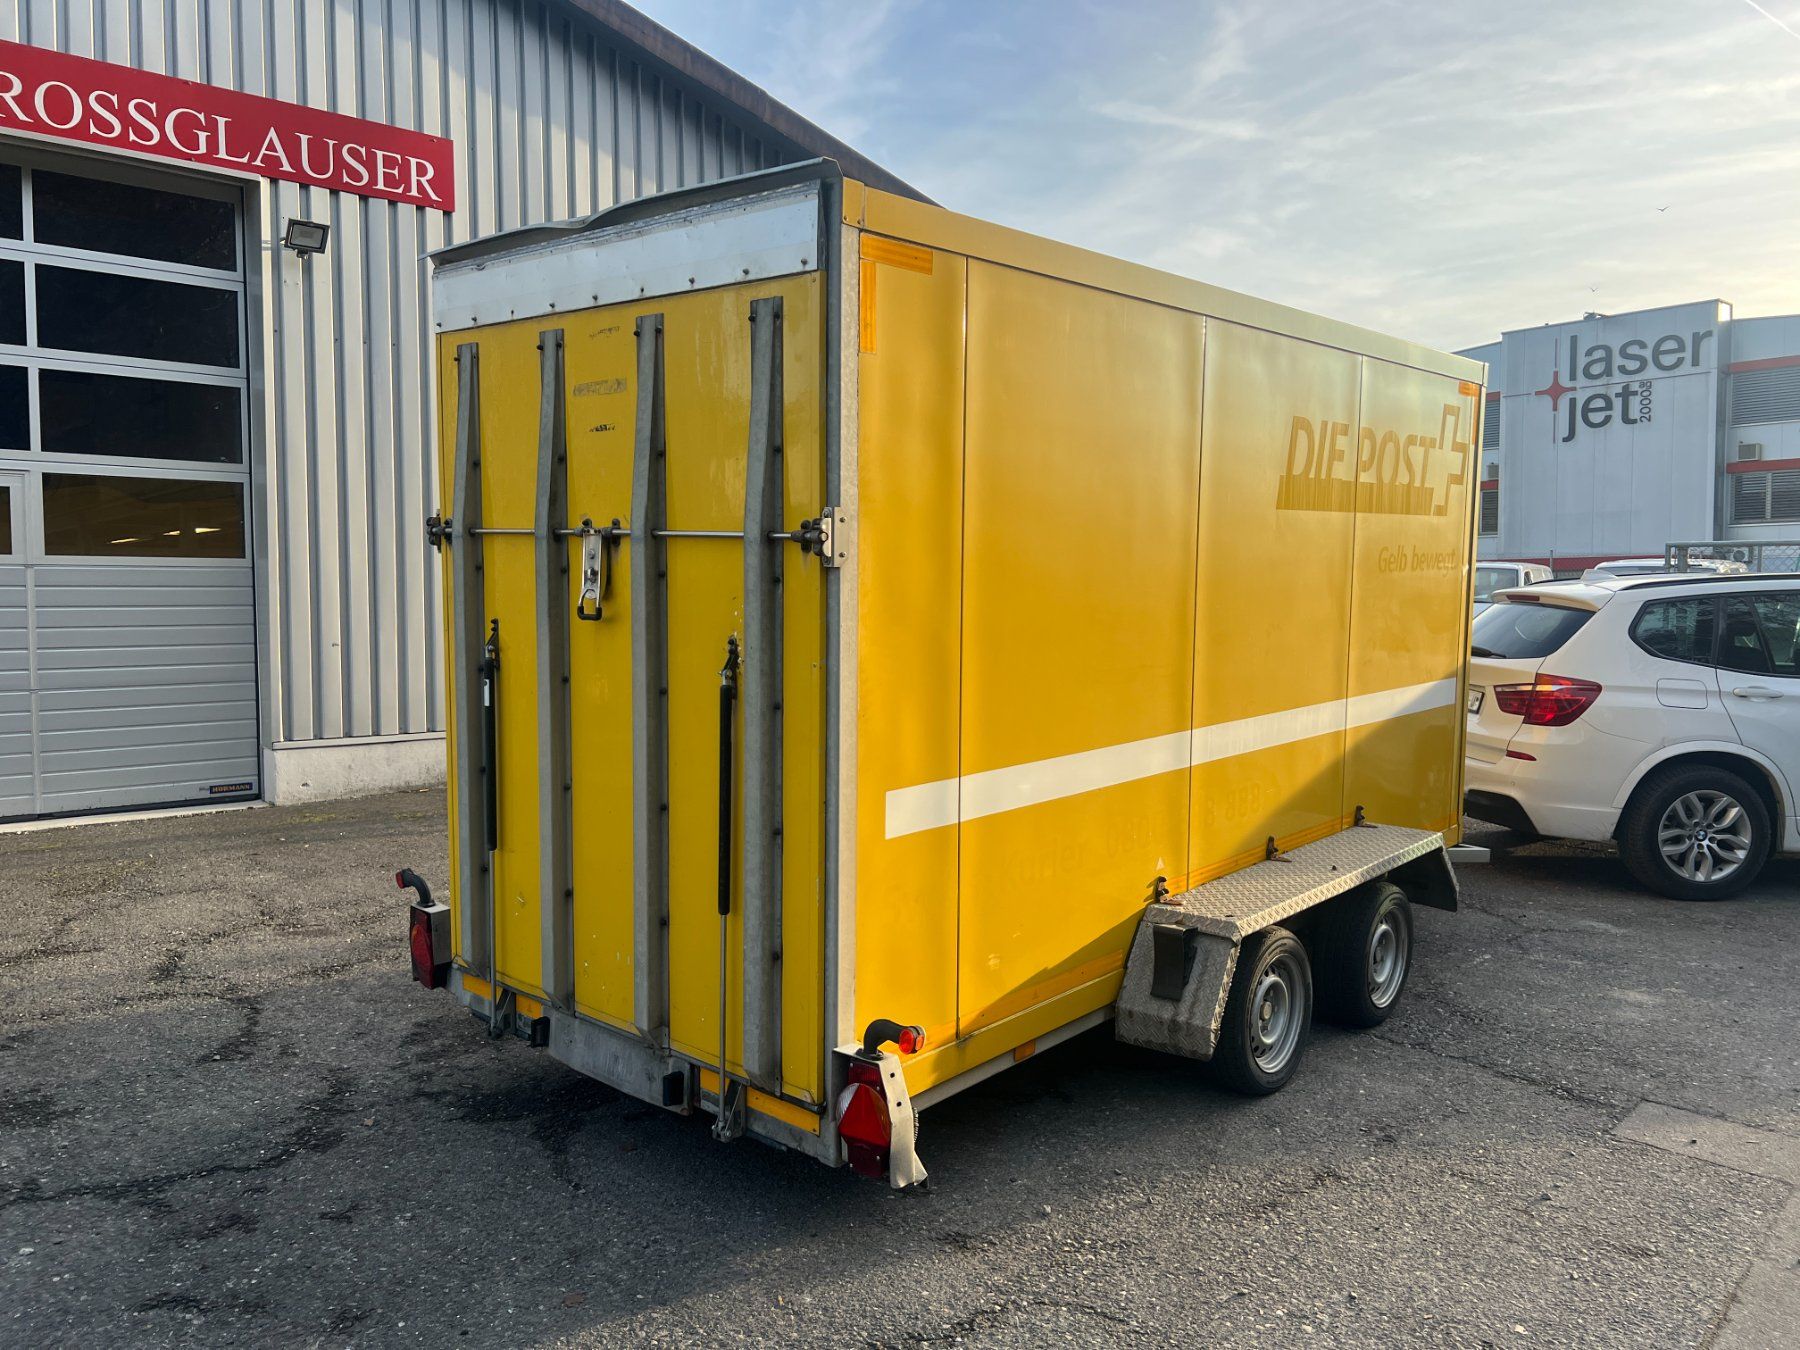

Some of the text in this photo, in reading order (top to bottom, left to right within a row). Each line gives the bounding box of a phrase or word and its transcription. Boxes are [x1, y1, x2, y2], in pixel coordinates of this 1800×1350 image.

[0, 71, 443, 202] ROSSGLAUSER
[1569, 330, 1713, 382] laser
[1562, 383, 1639, 442] jet
[1639, 389, 1652, 423] 2000
[1358, 426, 1437, 490] POST
[1378, 545, 1408, 573] Gelb
